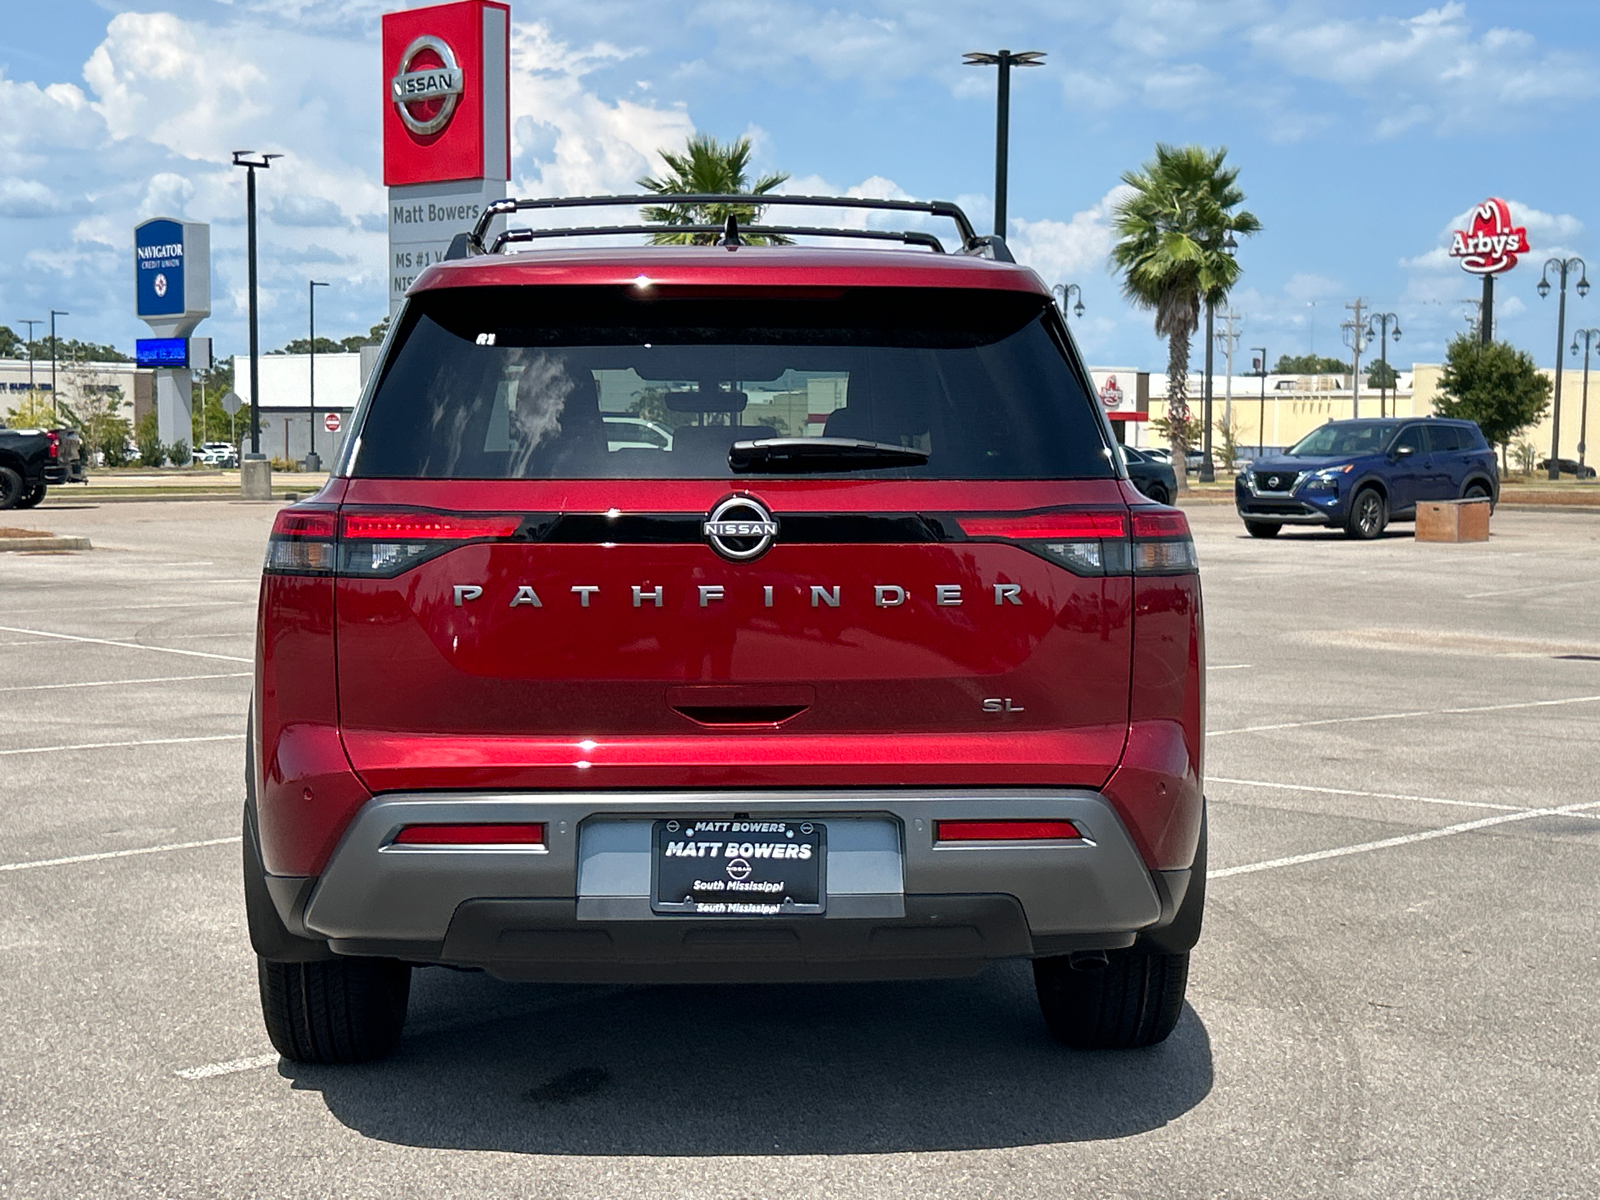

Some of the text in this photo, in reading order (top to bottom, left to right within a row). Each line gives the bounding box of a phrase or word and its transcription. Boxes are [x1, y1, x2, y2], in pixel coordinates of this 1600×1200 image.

[394, 74, 452, 96] NISSAN
[393, 204, 480, 224] Matt Bowers
[138, 243, 183, 260] NAVIGATOR
[1450, 228, 1519, 258] Arby's
[141, 259, 180, 270] CREDIT UNION
[395, 252, 412, 268] MS
[416, 251, 430, 267] #1
[705, 524, 776, 535] NISSAN
[453, 583, 1023, 608] PATHFINDER
[982, 698, 1025, 712] SL
[694, 822, 786, 833] MATT BOWERS
[665, 841, 812, 860] MATT BOWERS
[693, 880, 784, 892] South Mississippi
[696, 903, 780, 914] South Mississippi
